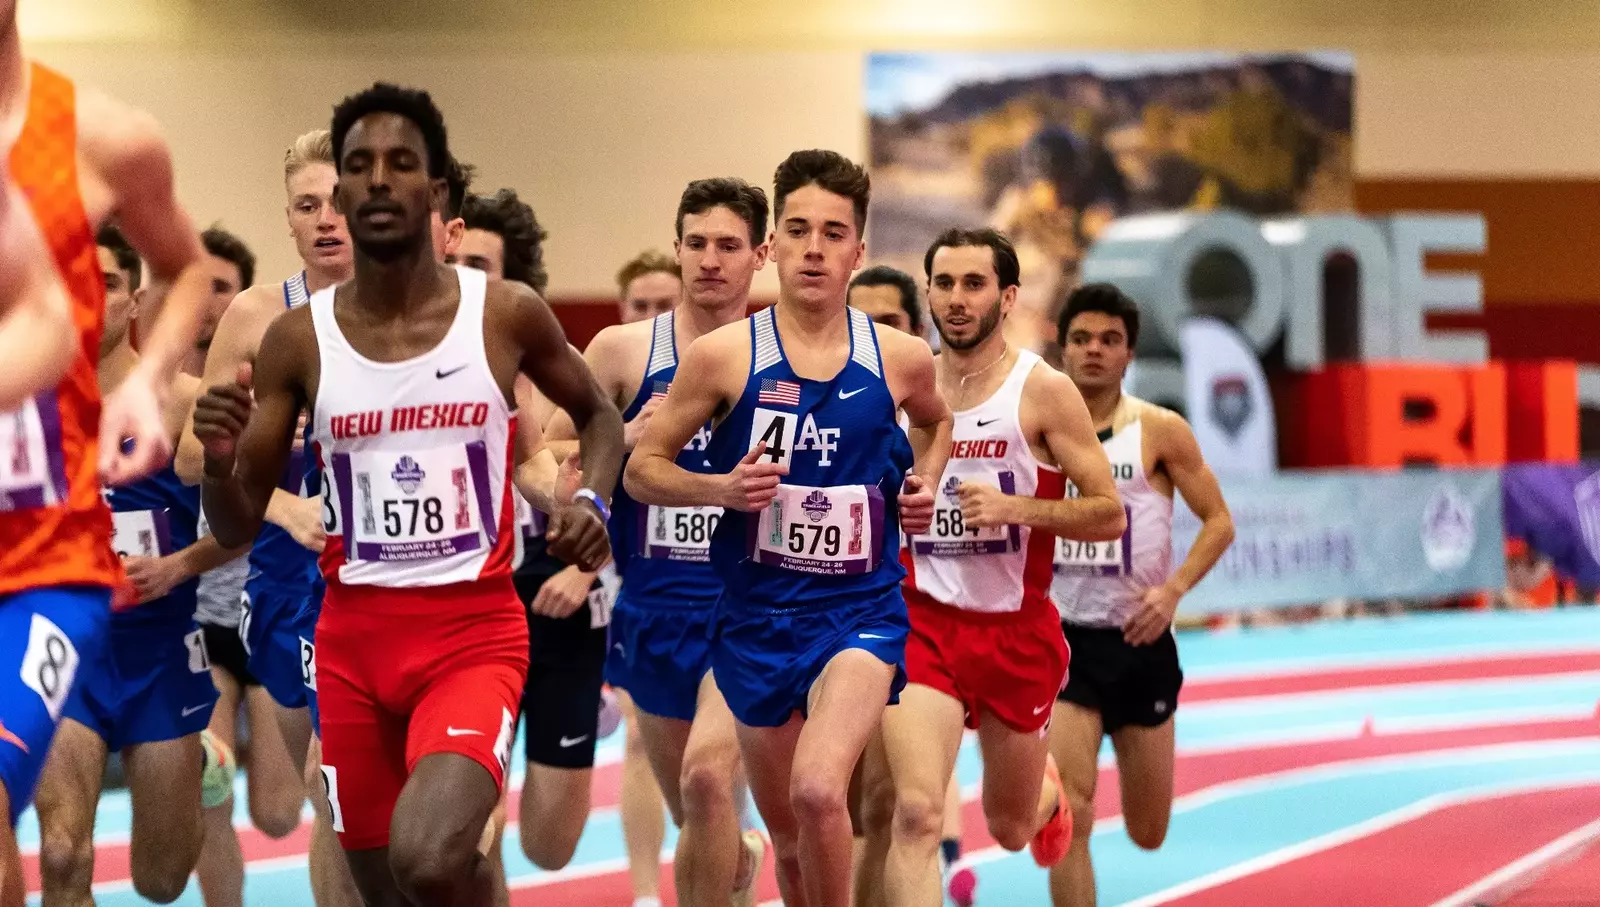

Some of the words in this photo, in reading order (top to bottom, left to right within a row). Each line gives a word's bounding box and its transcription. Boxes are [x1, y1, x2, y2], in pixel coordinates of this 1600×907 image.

[330, 410, 383, 440] NEW
[390, 402, 489, 432] MEXICO
[757, 415, 786, 464] 4
[794, 413, 841, 467] AF
[383, 496, 444, 538] 578
[674, 513, 721, 543] 580
[788, 522, 841, 557] 579
[783, 556, 820, 566] FEBRUARY
[39, 633, 67, 699] 8
